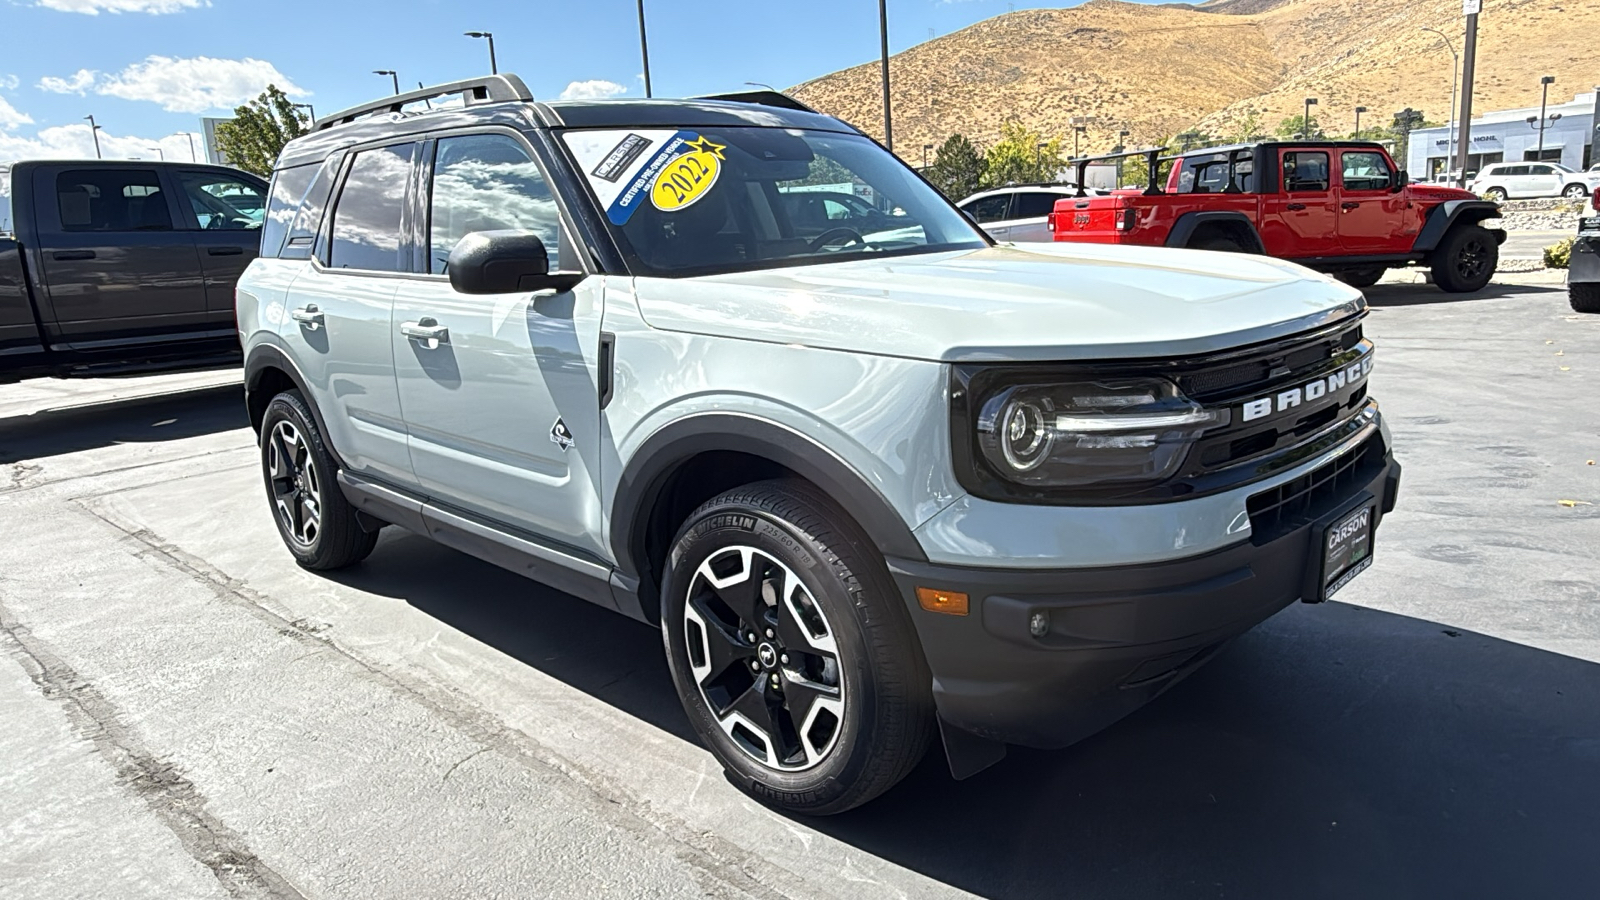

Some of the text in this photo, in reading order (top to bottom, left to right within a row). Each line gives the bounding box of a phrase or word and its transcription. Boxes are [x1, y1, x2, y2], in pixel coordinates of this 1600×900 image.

[597, 133, 641, 176] CARSON
[620, 177, 646, 207] CERTIFIED
[641, 153, 669, 181] PRE-OWNED
[664, 137, 685, 155] VEHICLE
[662, 156, 710, 204] 2022
[855, 188, 872, 196] FedEx
[1074, 214, 1090, 224] Jeep
[1243, 355, 1373, 422] BRONCO
[698, 516, 812, 565] MICHELIN 225/60 R 18
[1328, 513, 1368, 549] CARSON
